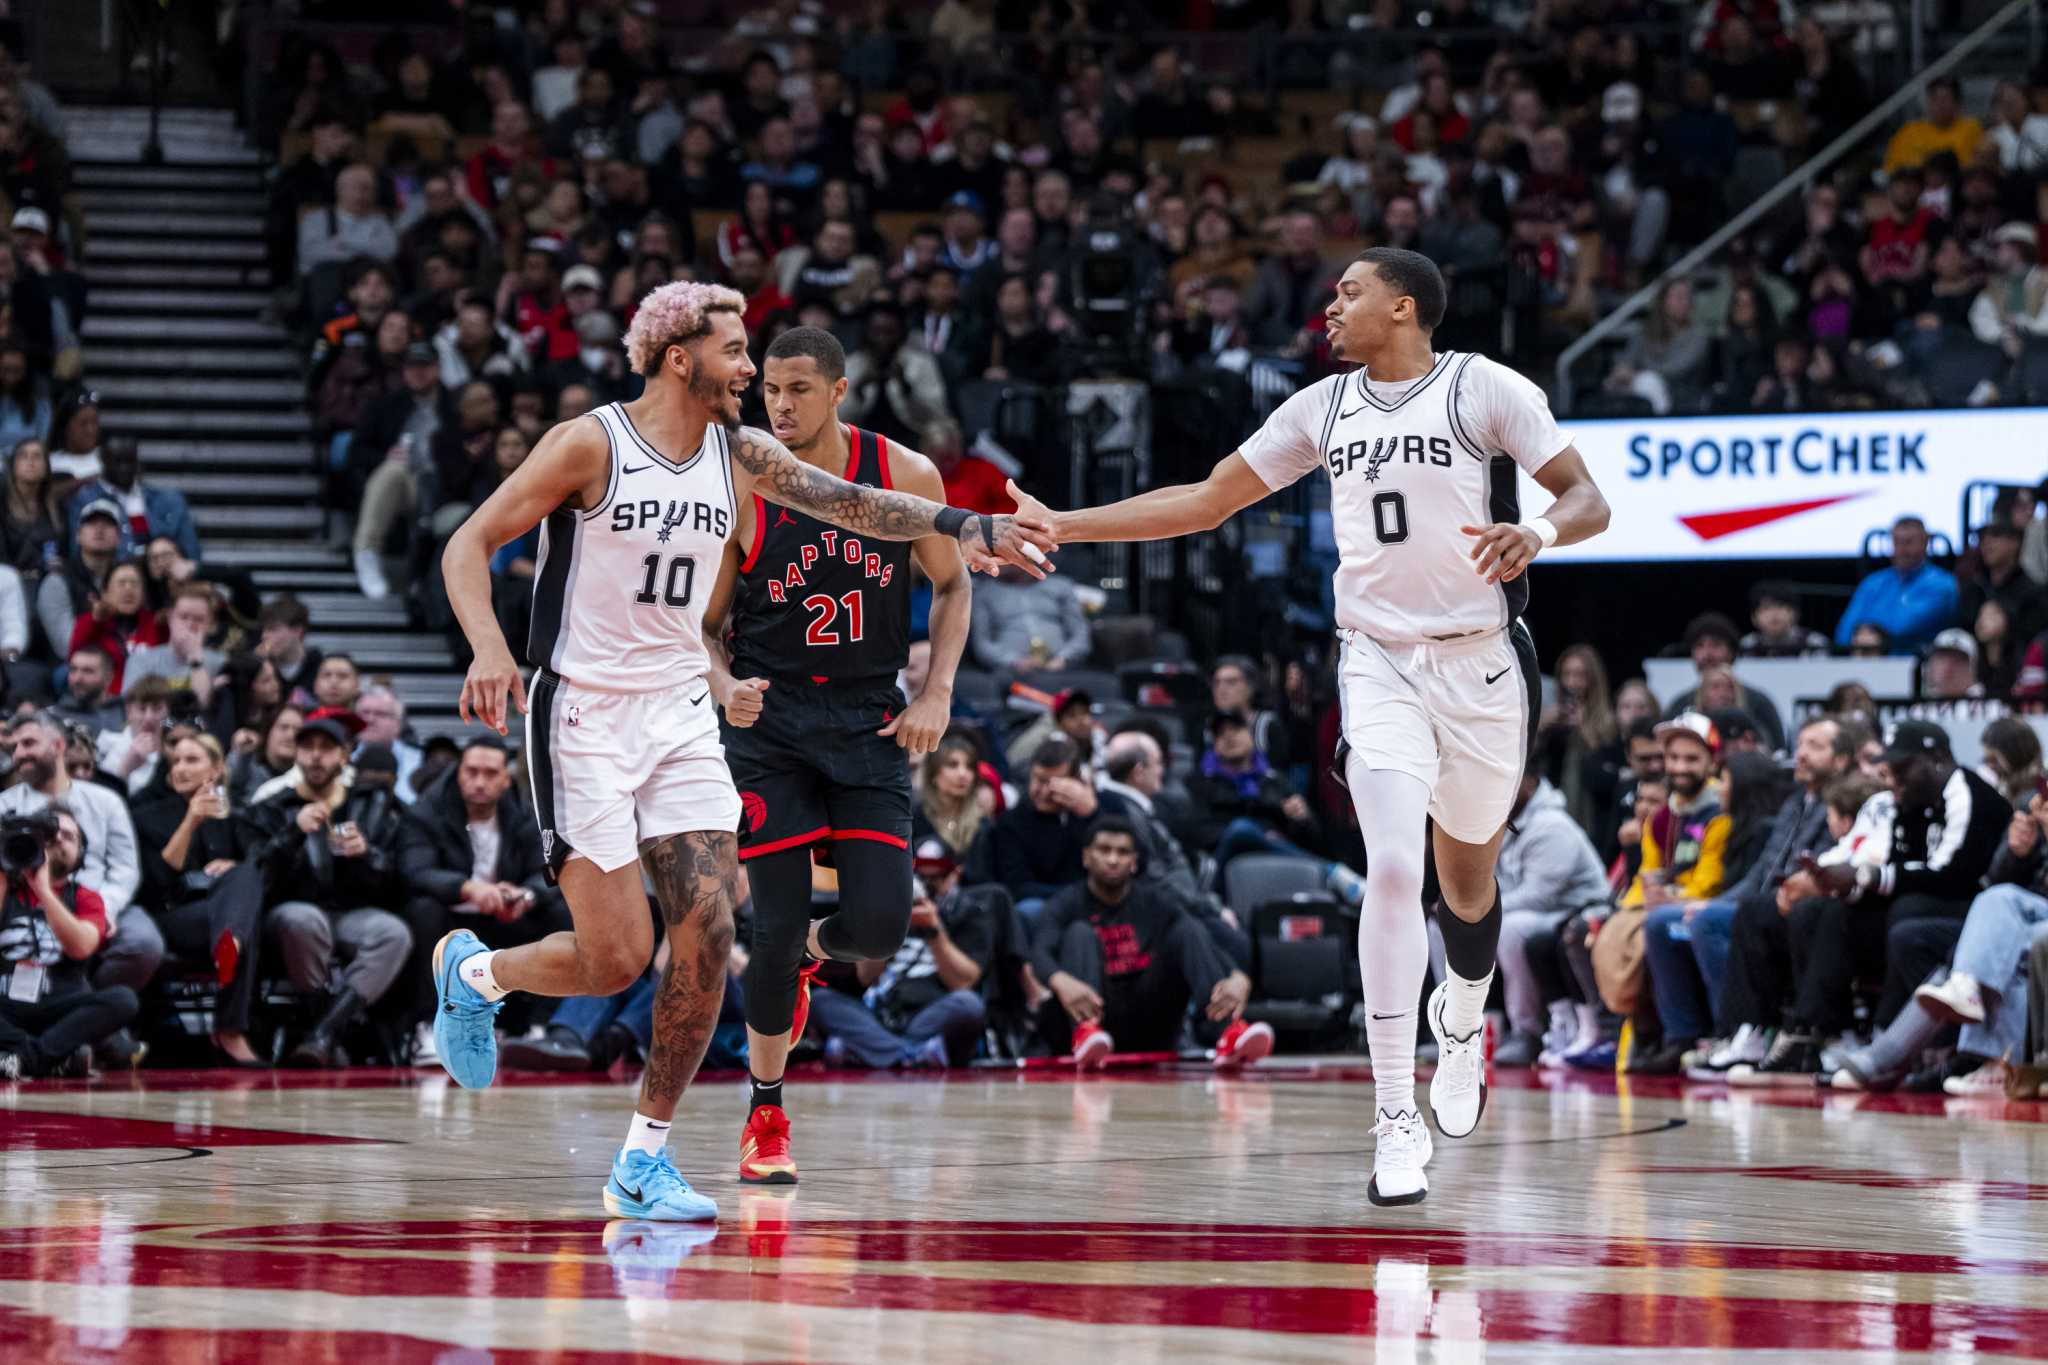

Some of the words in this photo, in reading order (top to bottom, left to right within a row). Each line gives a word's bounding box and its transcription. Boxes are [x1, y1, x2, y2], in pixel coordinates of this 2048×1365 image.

[1328, 435, 1452, 484] SPURS
[611, 500, 728, 544] SPURS
[1371, 489, 1410, 546] 0
[633, 552, 697, 609] 10
[768, 530, 894, 602] RAPTORS
[803, 590, 863, 646] 21
